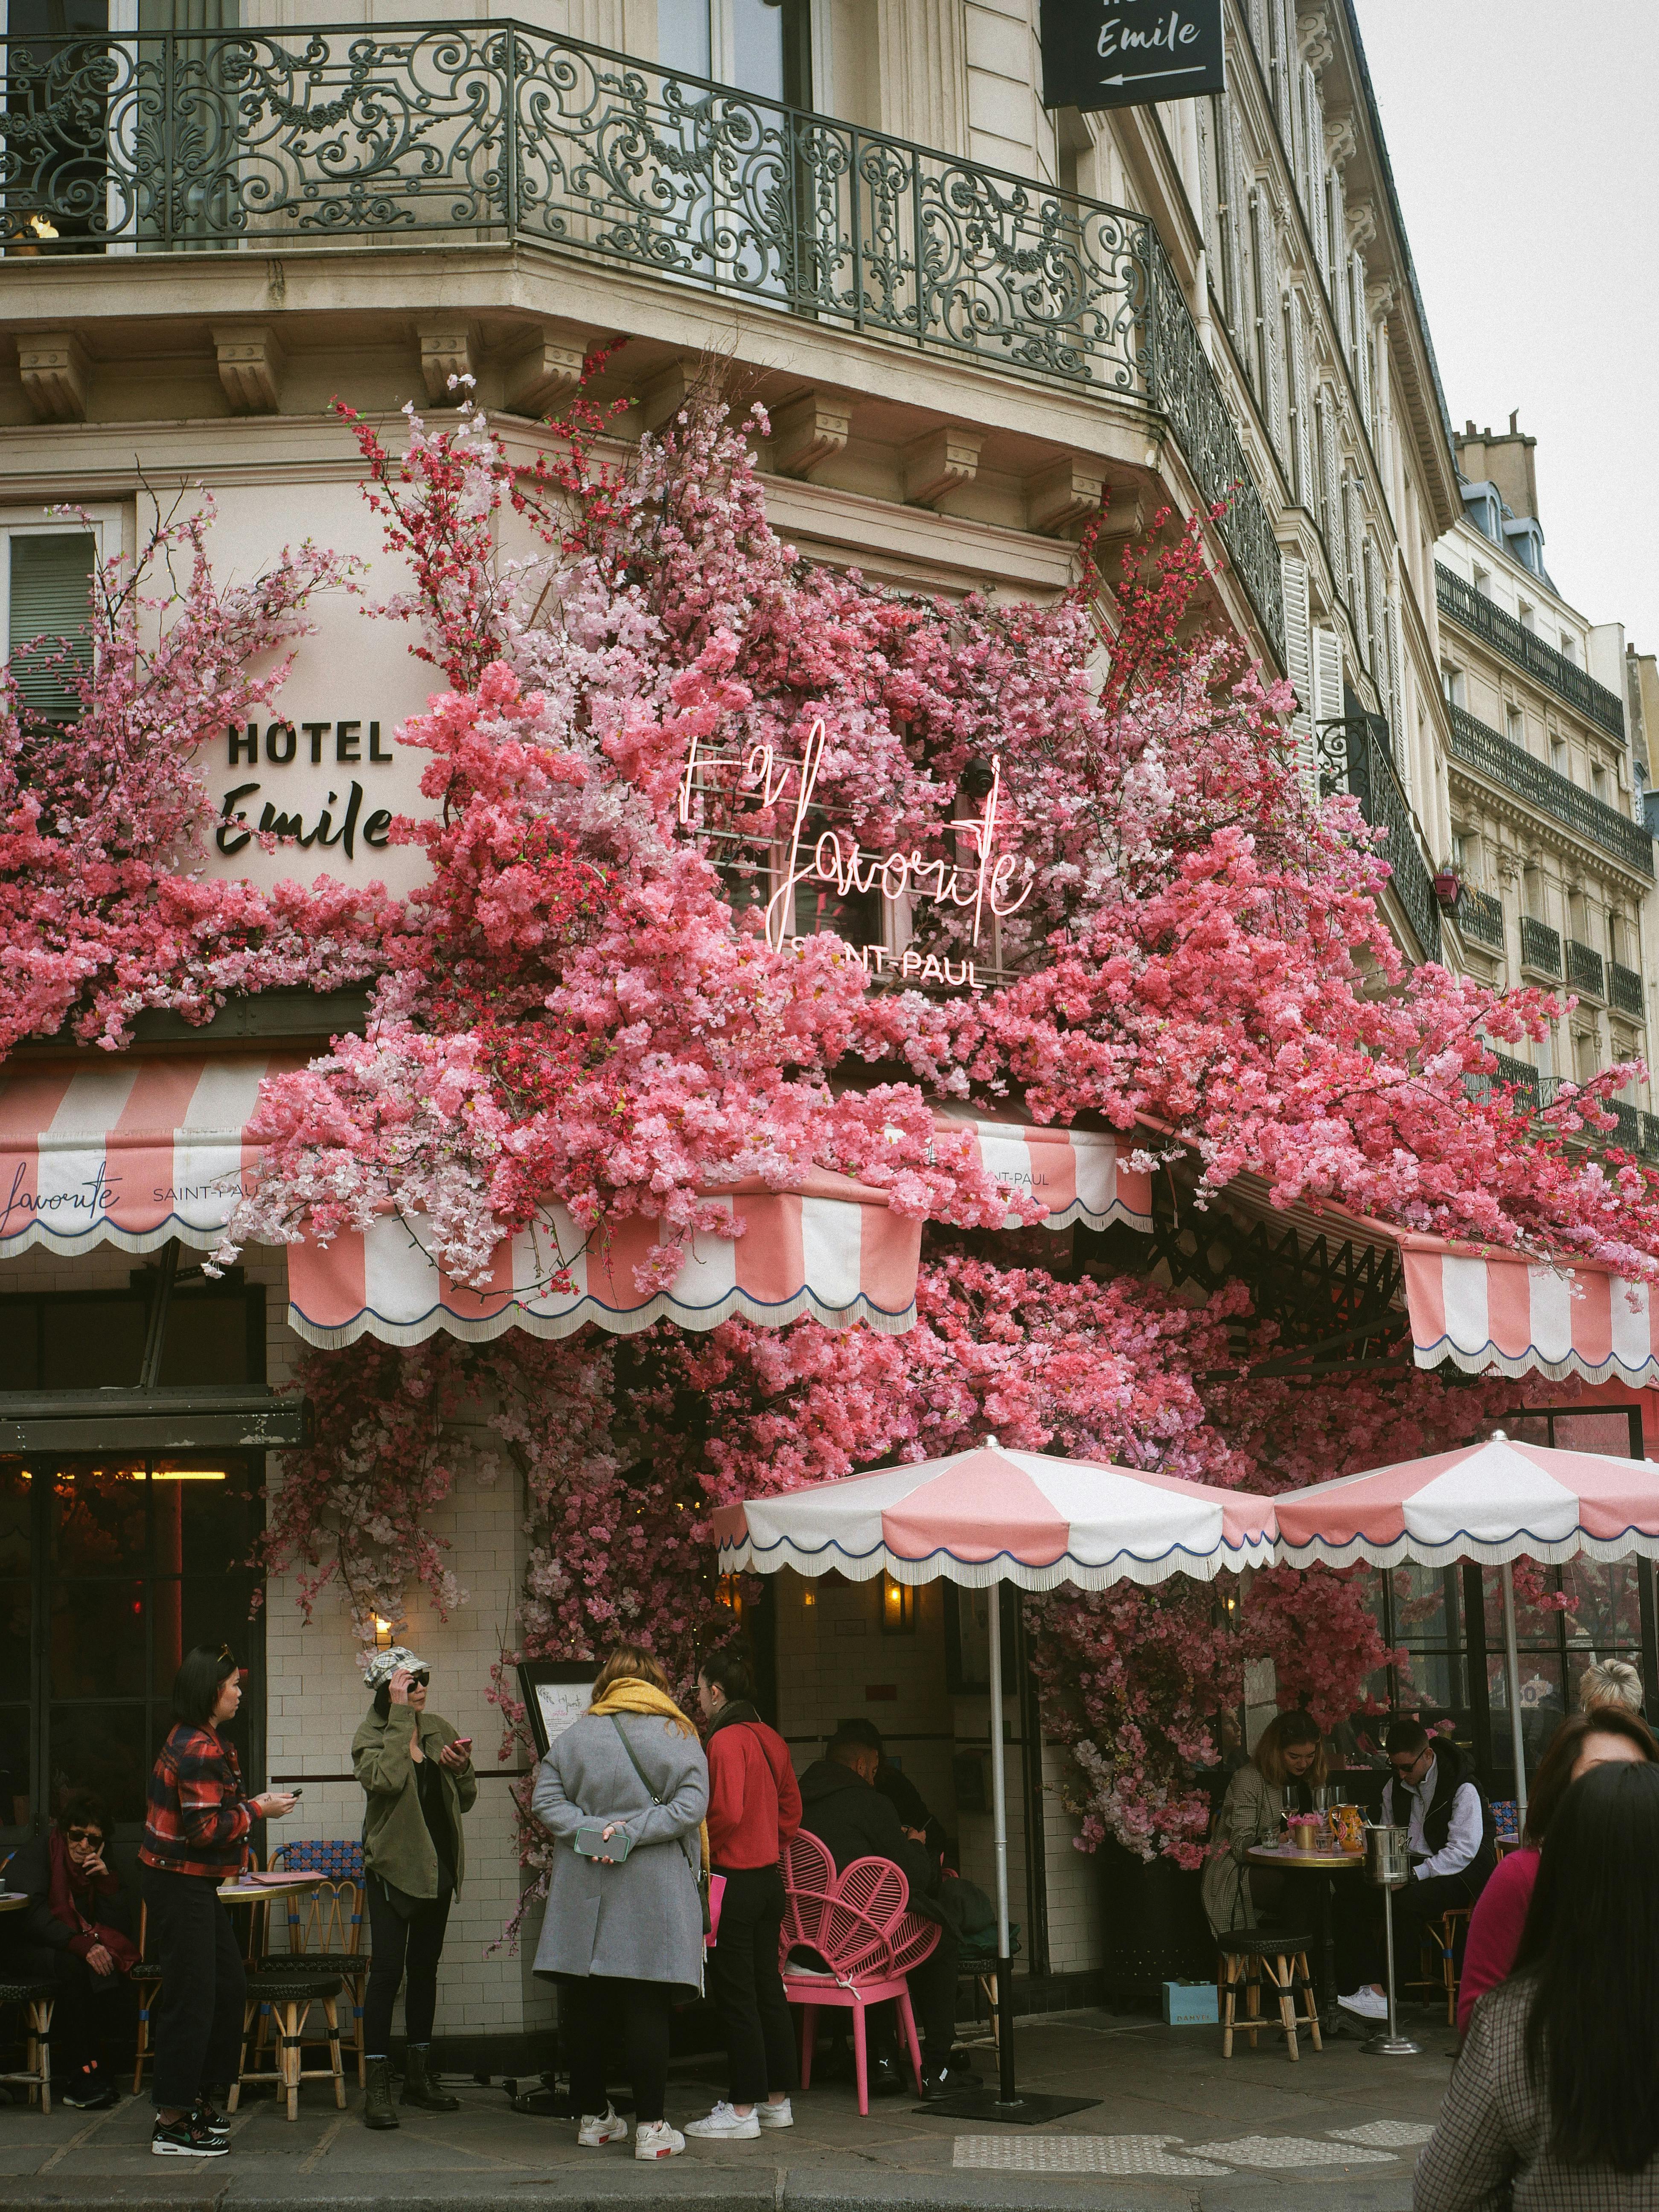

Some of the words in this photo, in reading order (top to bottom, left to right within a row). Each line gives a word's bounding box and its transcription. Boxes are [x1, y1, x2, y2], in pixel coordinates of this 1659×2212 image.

[1097, 11, 1201, 57] Emile
[229, 721, 393, 764] HOTEL
[216, 780, 393, 860] Emile
